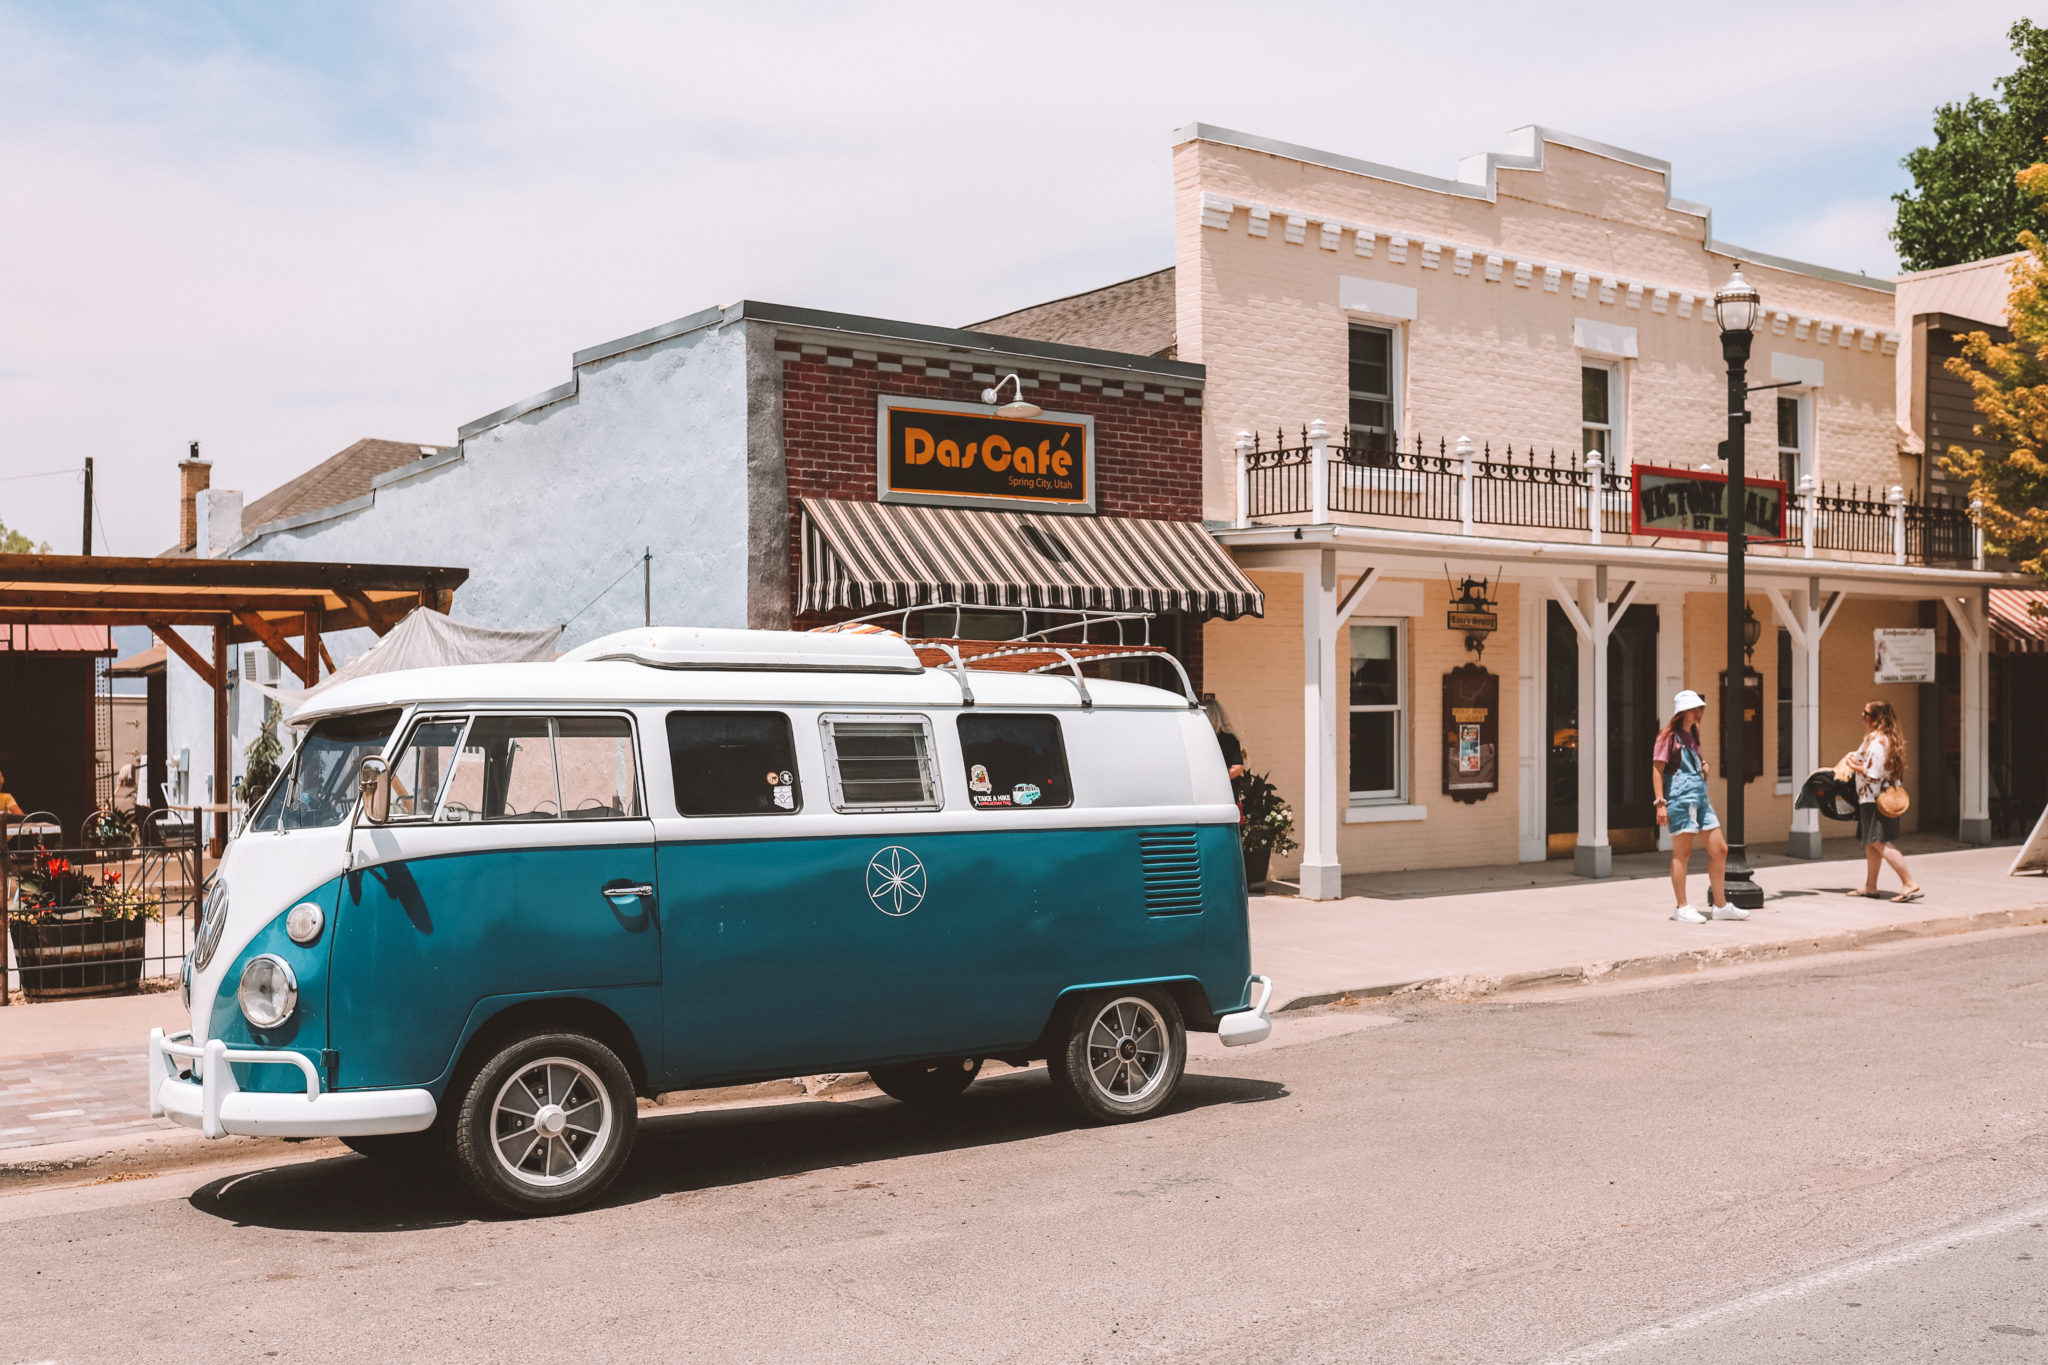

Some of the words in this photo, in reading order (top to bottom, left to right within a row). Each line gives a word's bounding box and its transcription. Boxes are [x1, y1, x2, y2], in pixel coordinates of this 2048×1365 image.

[1008, 475, 1035, 489] Spring
[1036, 477, 1053, 490] City,
[1054, 479, 1073, 489] Utah
